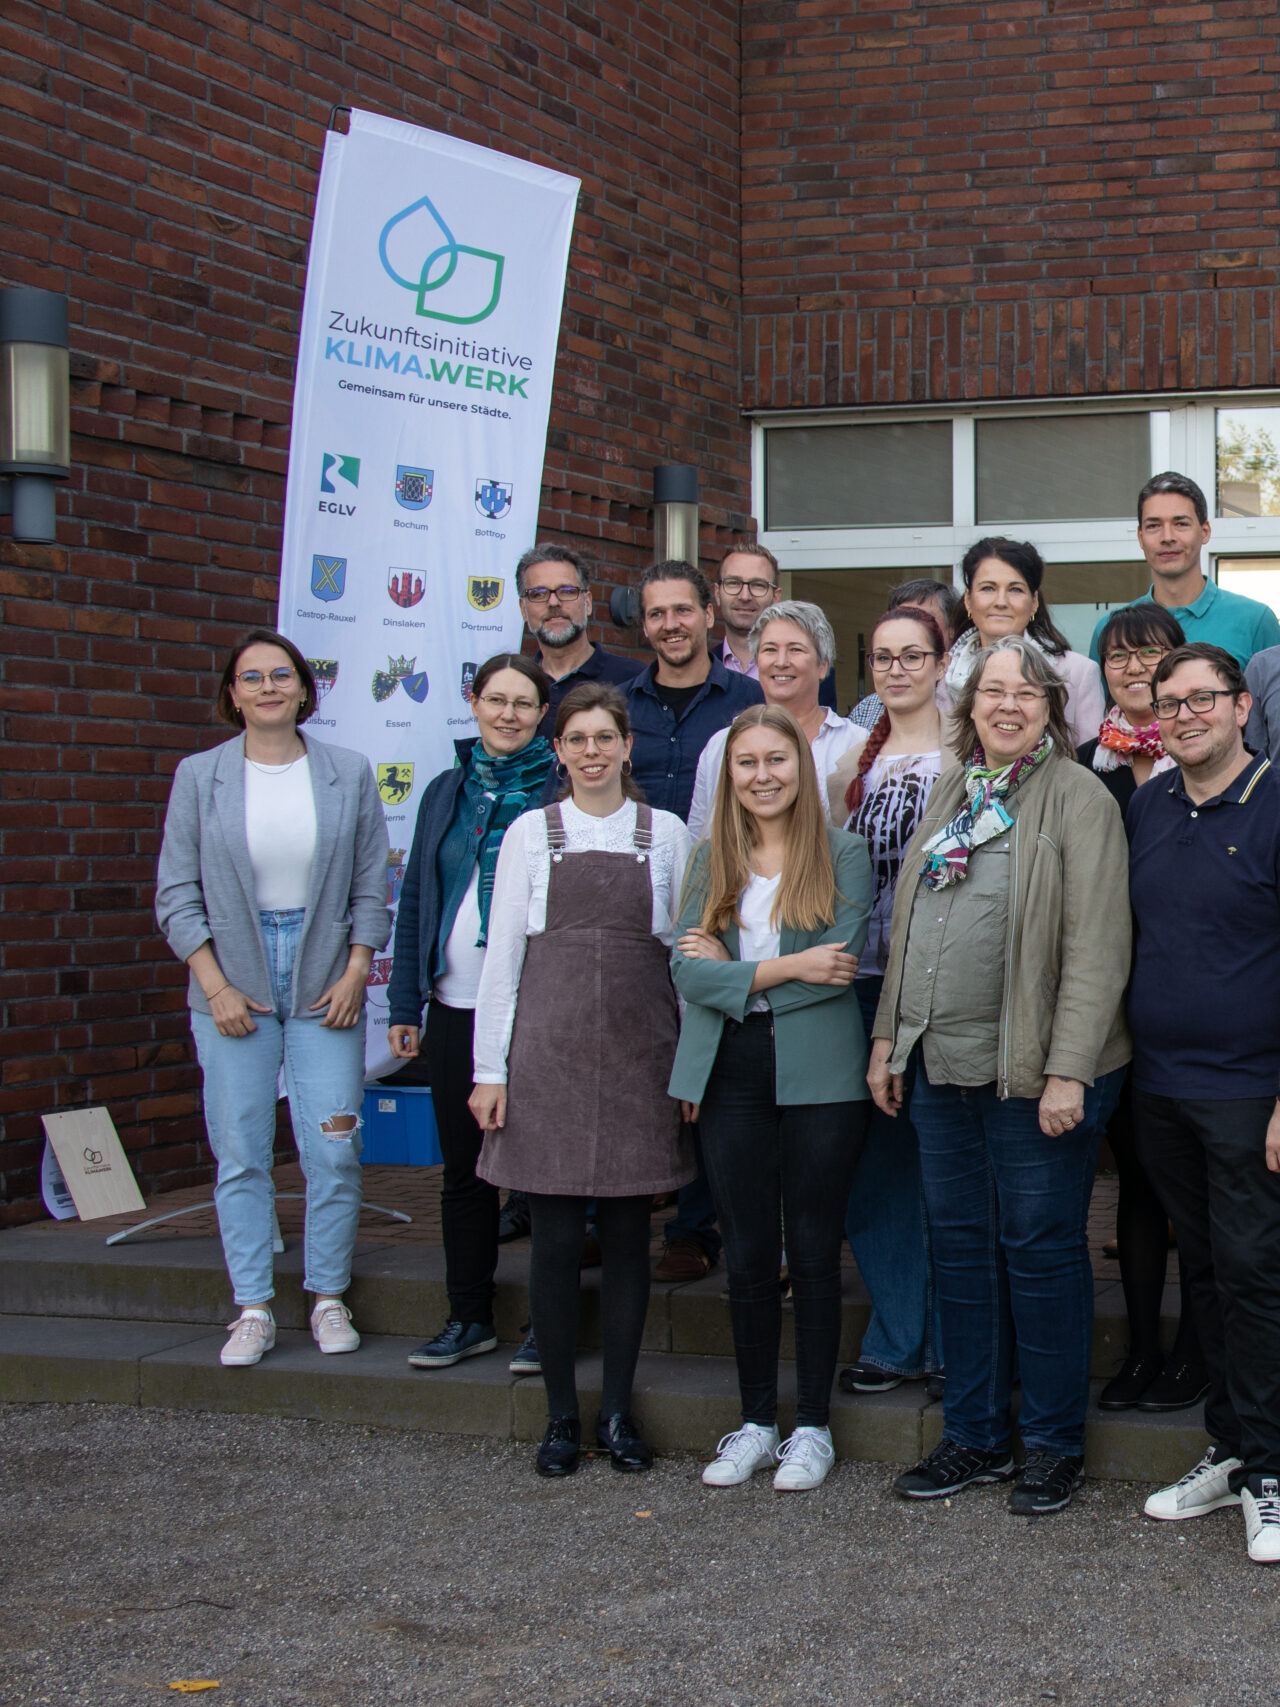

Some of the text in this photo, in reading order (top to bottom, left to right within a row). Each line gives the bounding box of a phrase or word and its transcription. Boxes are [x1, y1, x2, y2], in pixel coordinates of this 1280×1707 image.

[329, 310, 533, 370] Zukunftsinitiative
[325, 337, 530, 399] KLIMA.WERK
[338, 379, 512, 420] Gemeinsam für unsere Städte.
[318, 501, 356, 516] EGLV
[393, 520, 429, 531] Bochum
[475, 528, 506, 539] Bottrop
[297, 609, 356, 623] Castrop-Rauxel
[383, 618, 426, 628] Dinslaken
[461, 622, 503, 632] Dortmund
[306, 717, 336, 728] uisburg
[386, 719, 411, 728] Essen
